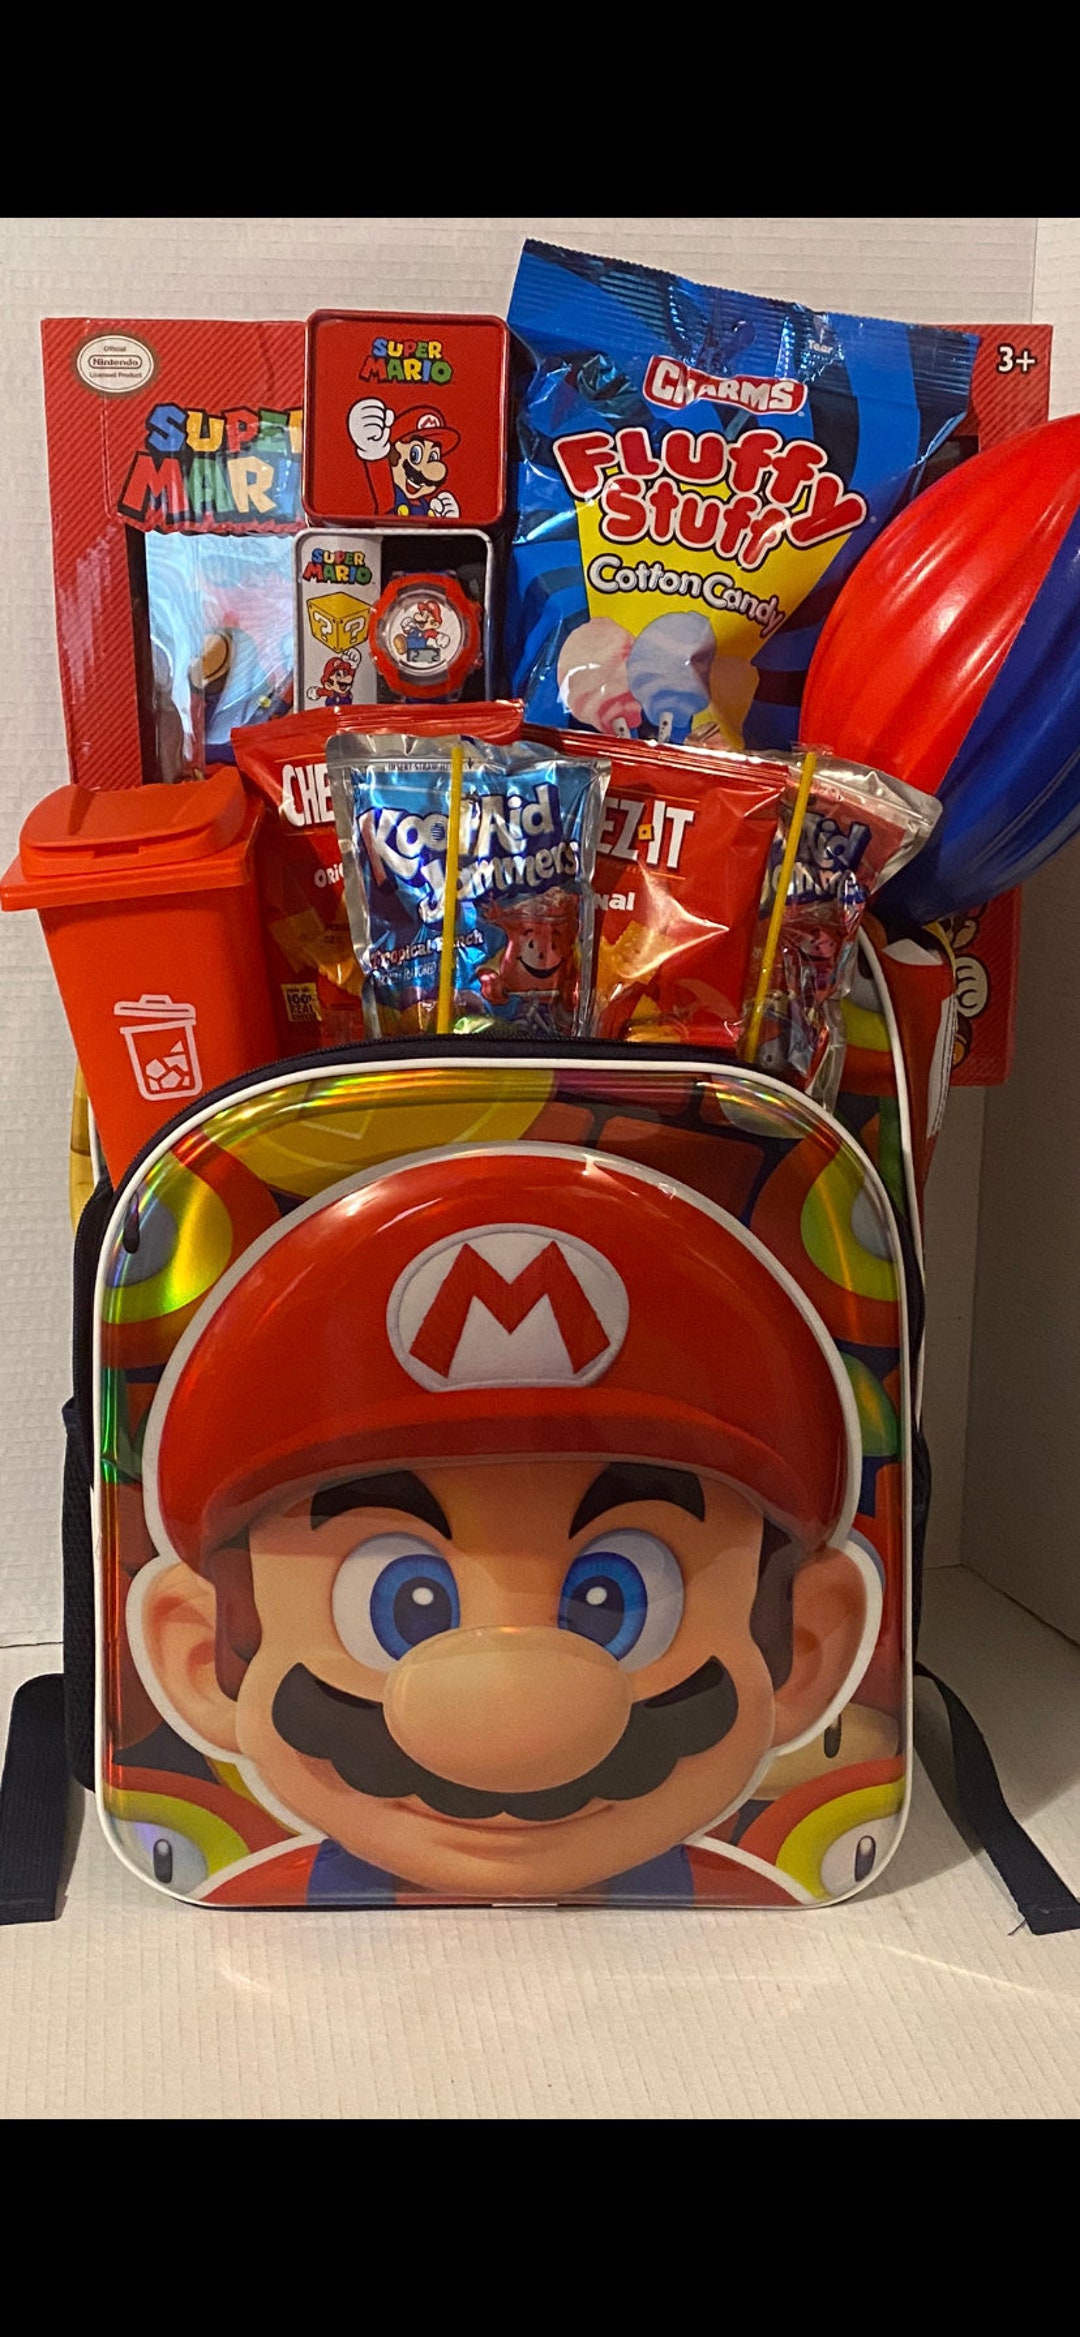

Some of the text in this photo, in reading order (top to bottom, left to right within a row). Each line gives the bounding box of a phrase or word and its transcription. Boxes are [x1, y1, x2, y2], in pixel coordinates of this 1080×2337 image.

[103, 345, 127, 353] Official
[372, 337, 443, 359] SUPER
[808, 338, 833, 354] Tear
[92, 358, 139, 367] Nintendo
[997, 344, 1036, 373] 3+
[89, 371, 143, 379] Licensed Product
[359, 356, 454, 385] MARIO
[600, 476, 790, 571] Stuff
[312, 548, 365, 566] SUPER
[302, 562, 372, 585] MARIO
[588, 555, 786, 635] Cotton Candy
[370, 938, 433, 970] Tropical
[408, 1239, 611, 1379] M
